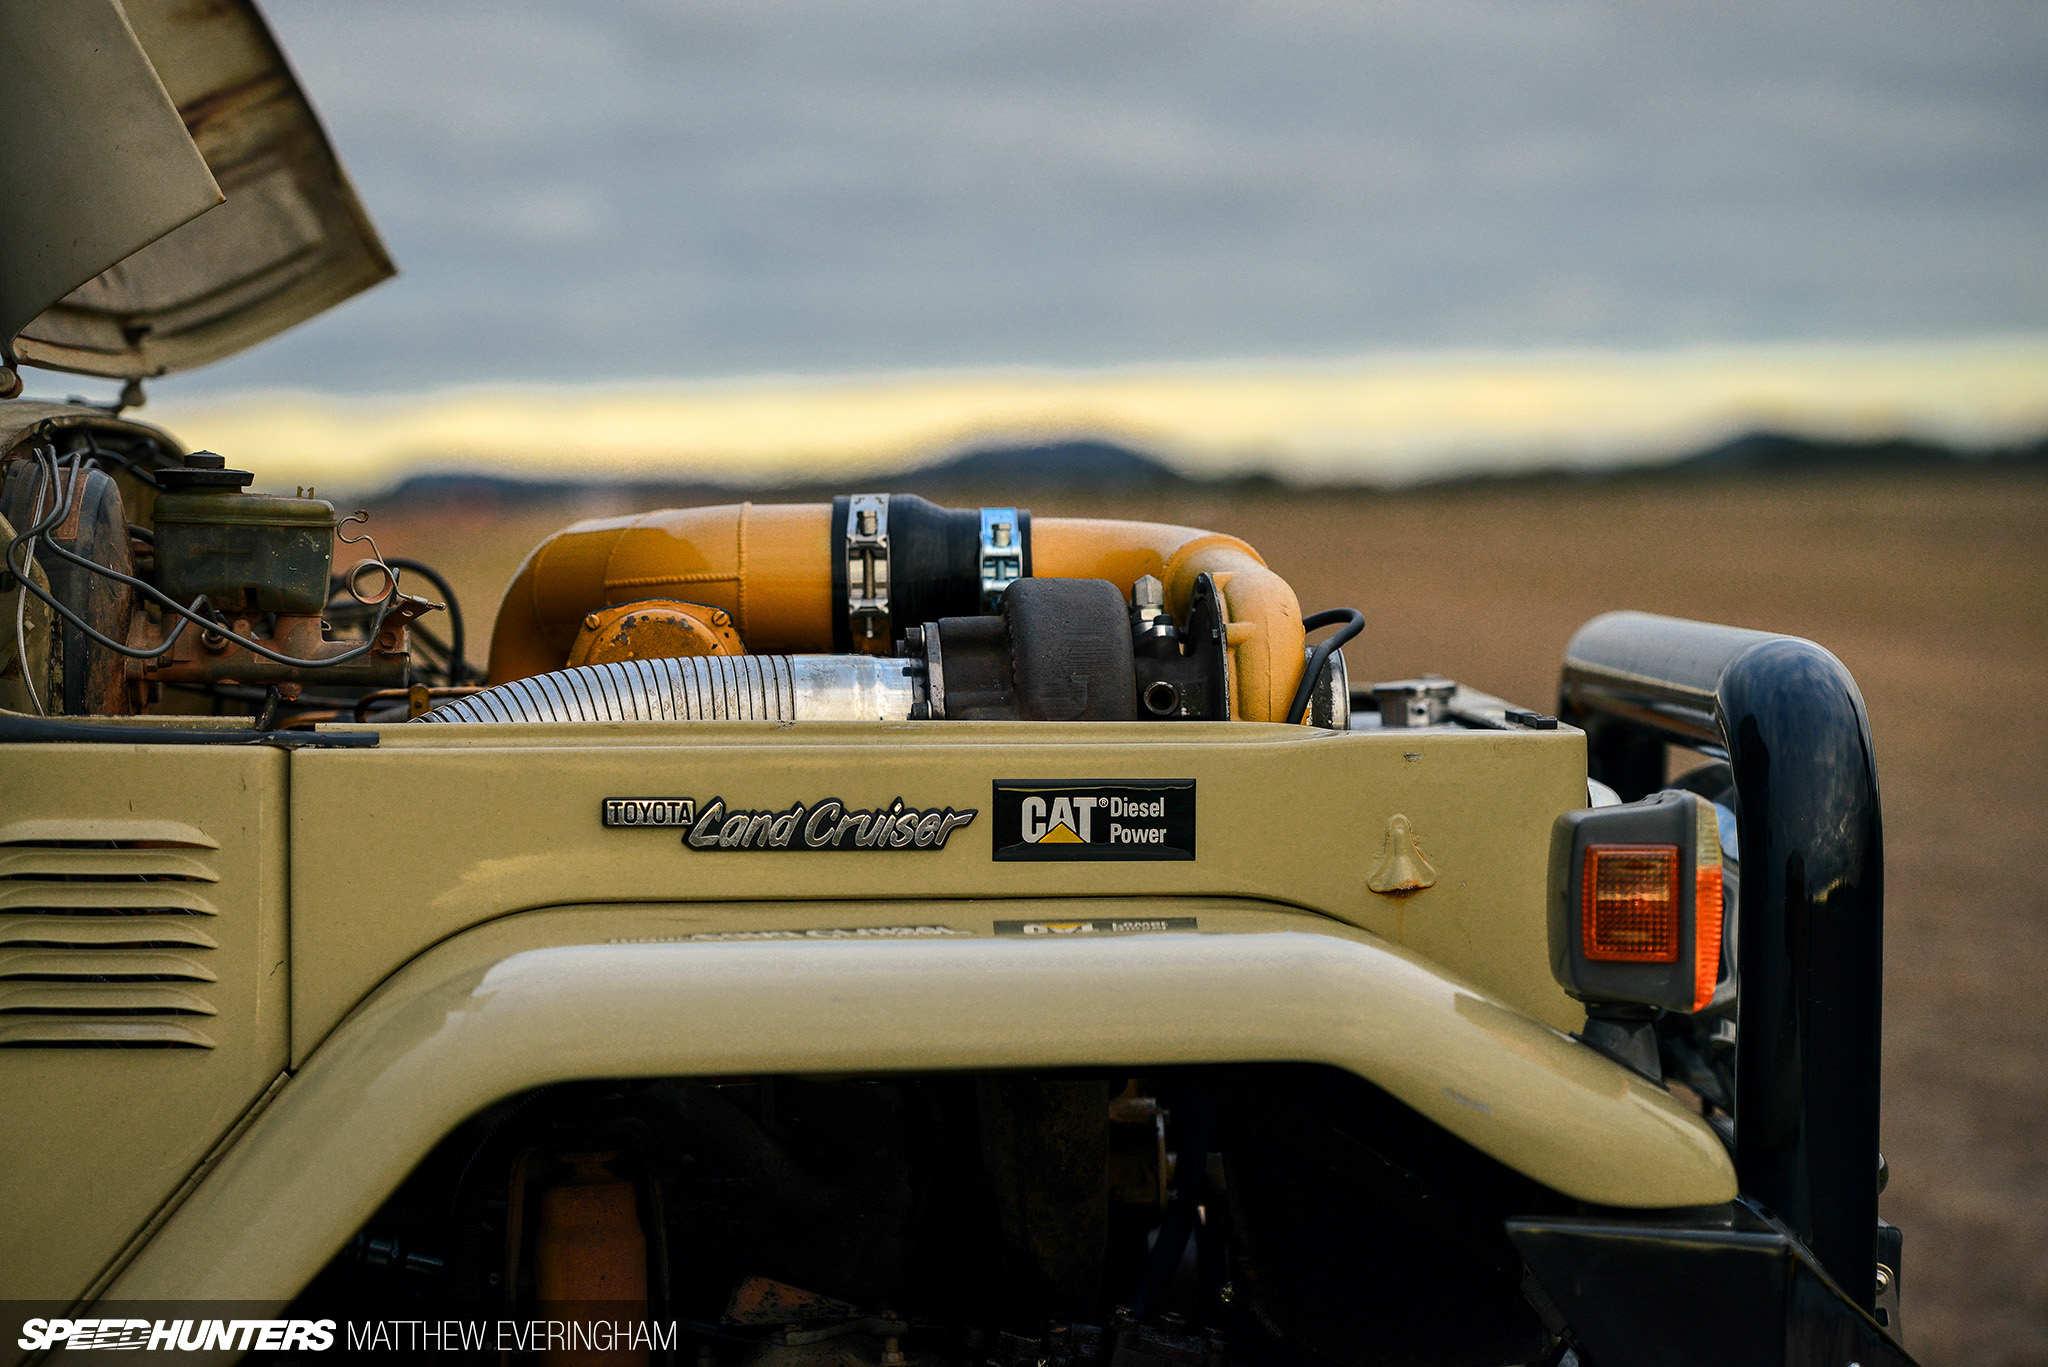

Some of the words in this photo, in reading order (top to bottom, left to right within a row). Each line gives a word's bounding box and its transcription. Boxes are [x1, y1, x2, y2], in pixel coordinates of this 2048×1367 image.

[1110, 797, 1165, 818] Diesel
[606, 800, 693, 826] TOYOTA
[688, 799, 805, 848] Land
[805, 801, 974, 848] Cruiser
[1110, 823, 1167, 844] Power
